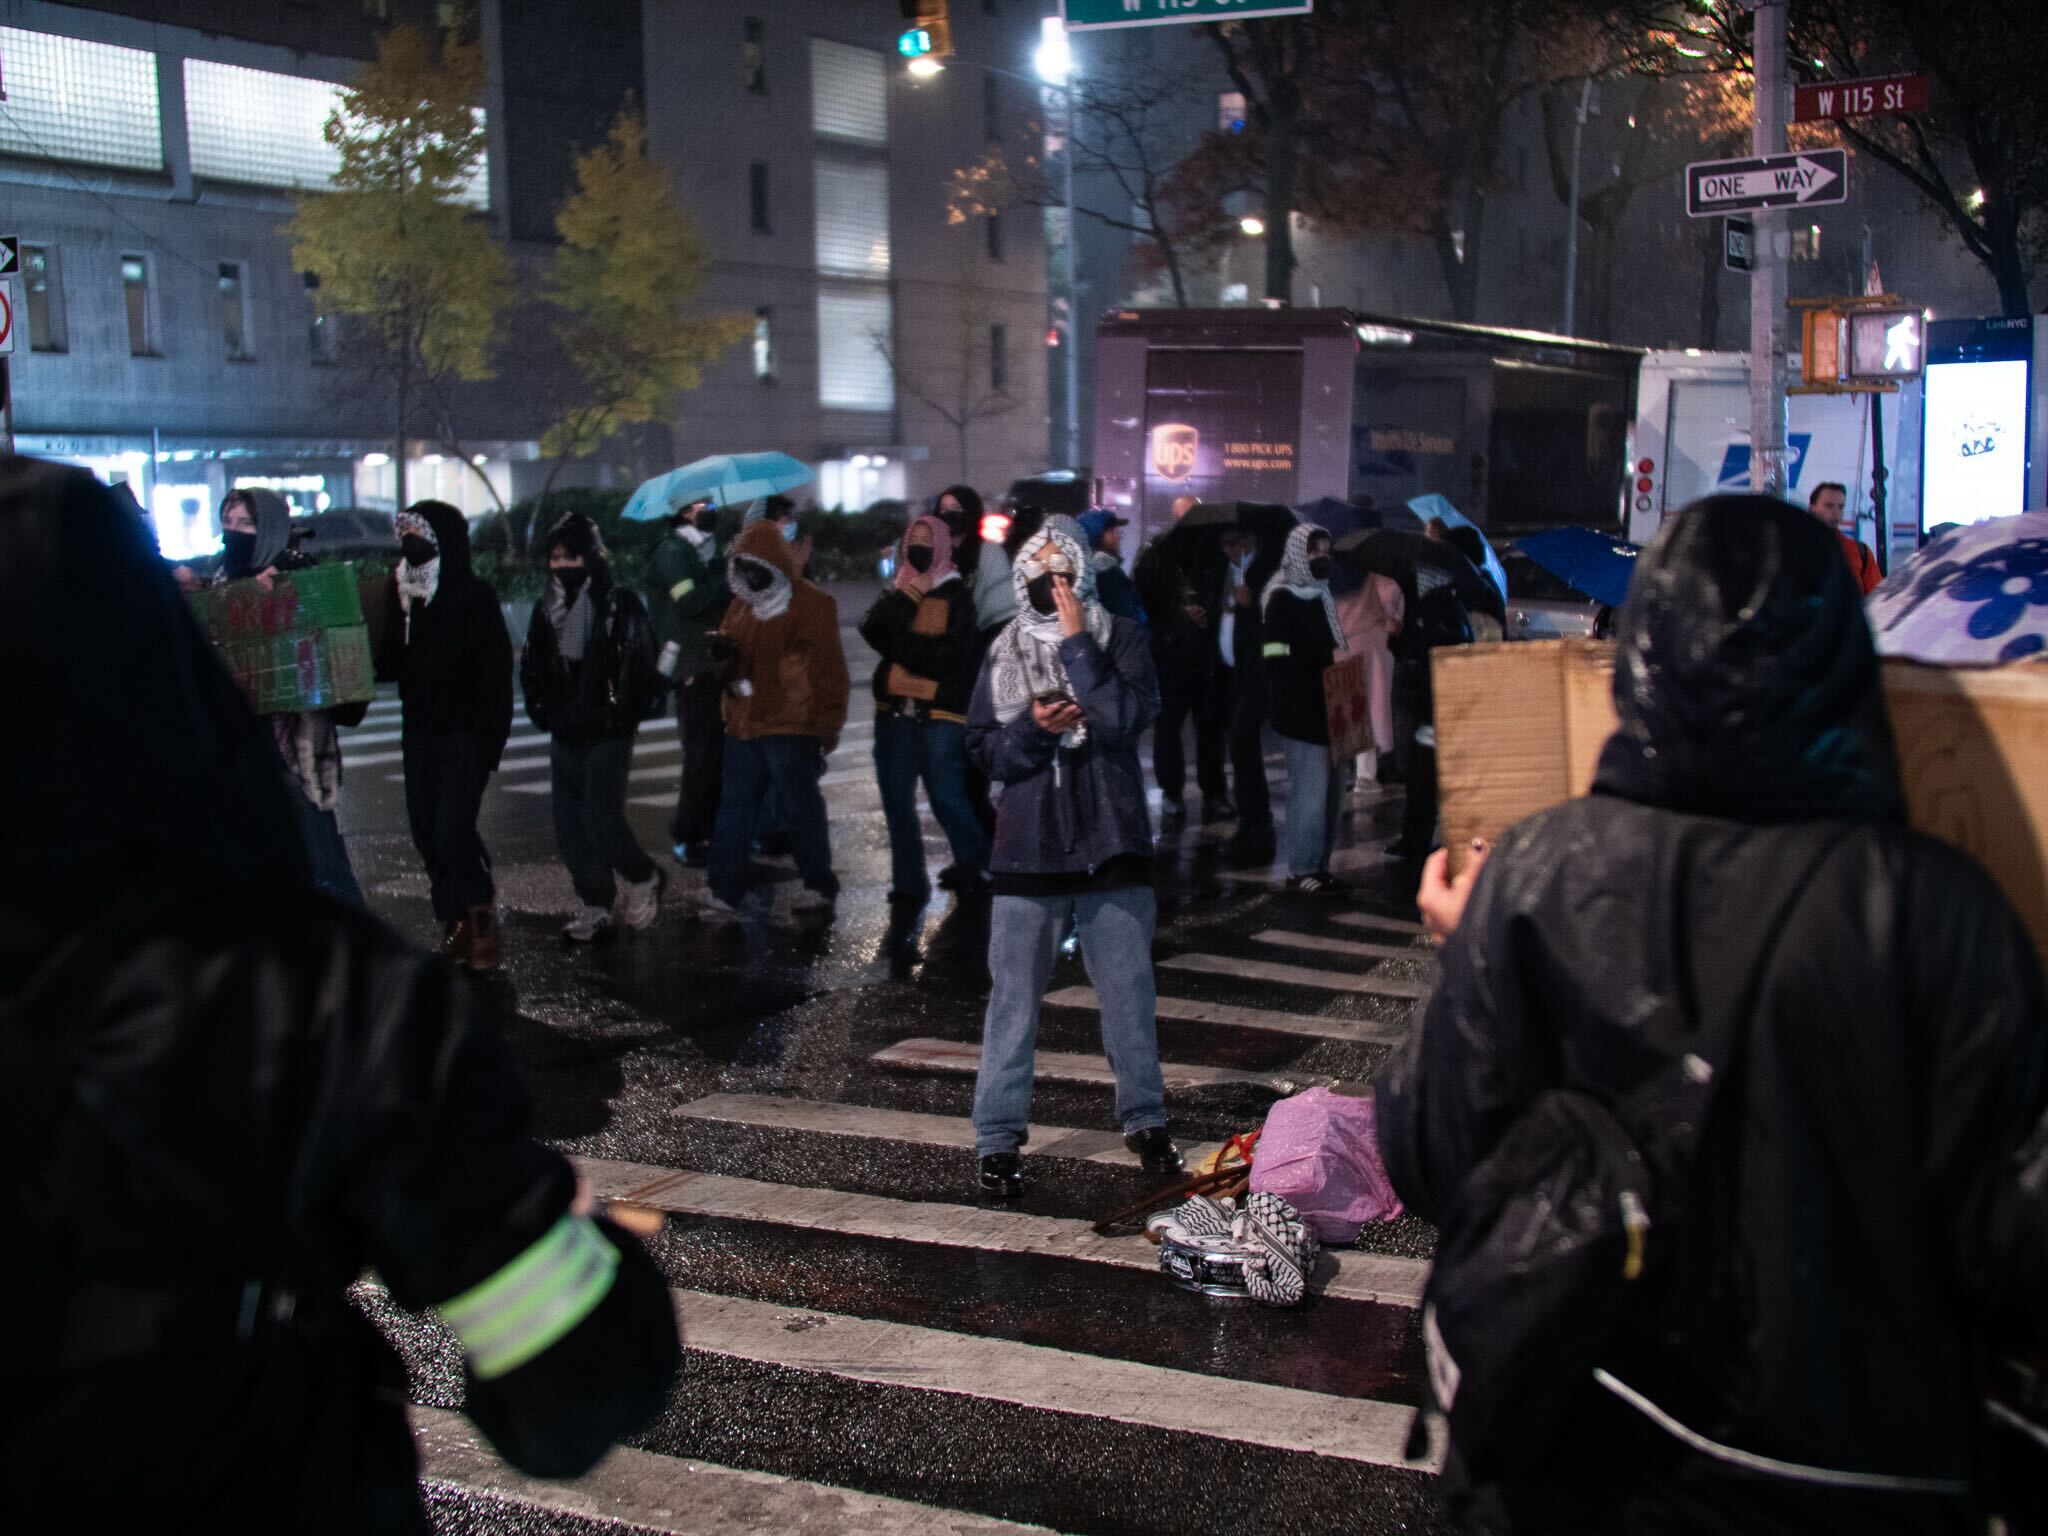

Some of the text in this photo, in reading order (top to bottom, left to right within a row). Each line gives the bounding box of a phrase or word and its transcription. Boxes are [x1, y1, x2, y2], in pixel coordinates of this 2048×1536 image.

[1818, 83, 1905, 116] W 115 St
[1704, 167, 1817, 198] ONE WAY
[1154, 441, 1195, 475] ups
[1274, 443, 1294, 457] UPS
